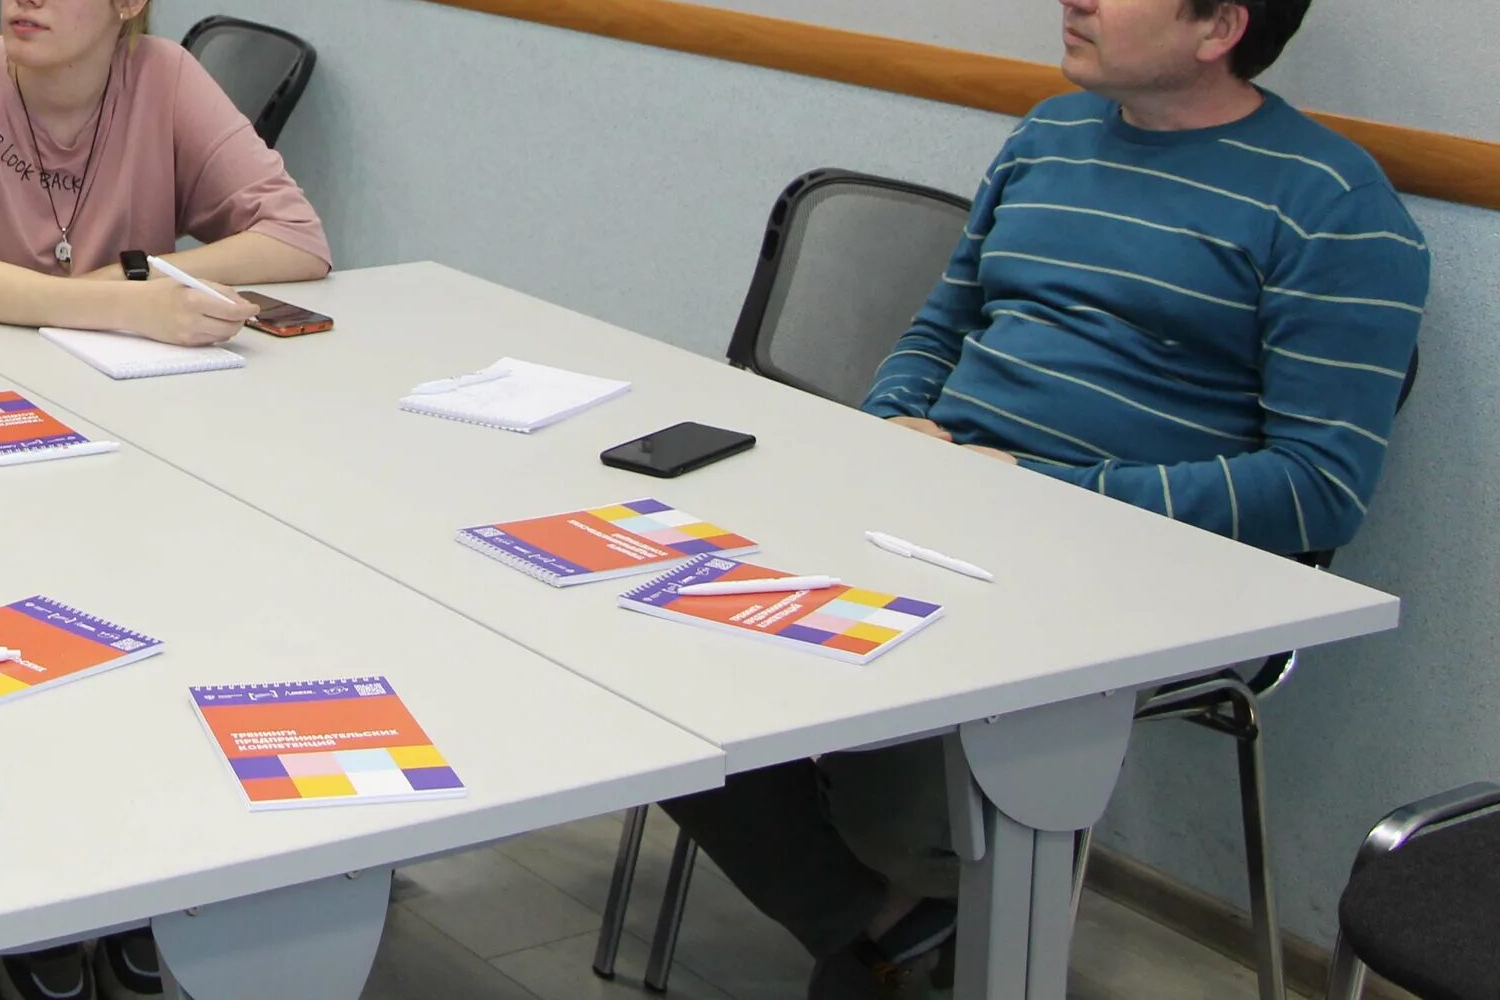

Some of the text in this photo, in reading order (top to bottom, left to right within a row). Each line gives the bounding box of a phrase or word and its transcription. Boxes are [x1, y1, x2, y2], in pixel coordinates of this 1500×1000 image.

[1, 144, 35, 182] LOOK
[40, 171, 82, 193] BACK
[231, 729, 297, 739] ТРЕНИНГИ
[234, 728, 399, 745] ПРЕДПРИНИМАТЕЛЬСКИХ
[238, 739, 337, 752] КОМПЕТЕНЦИЙ
